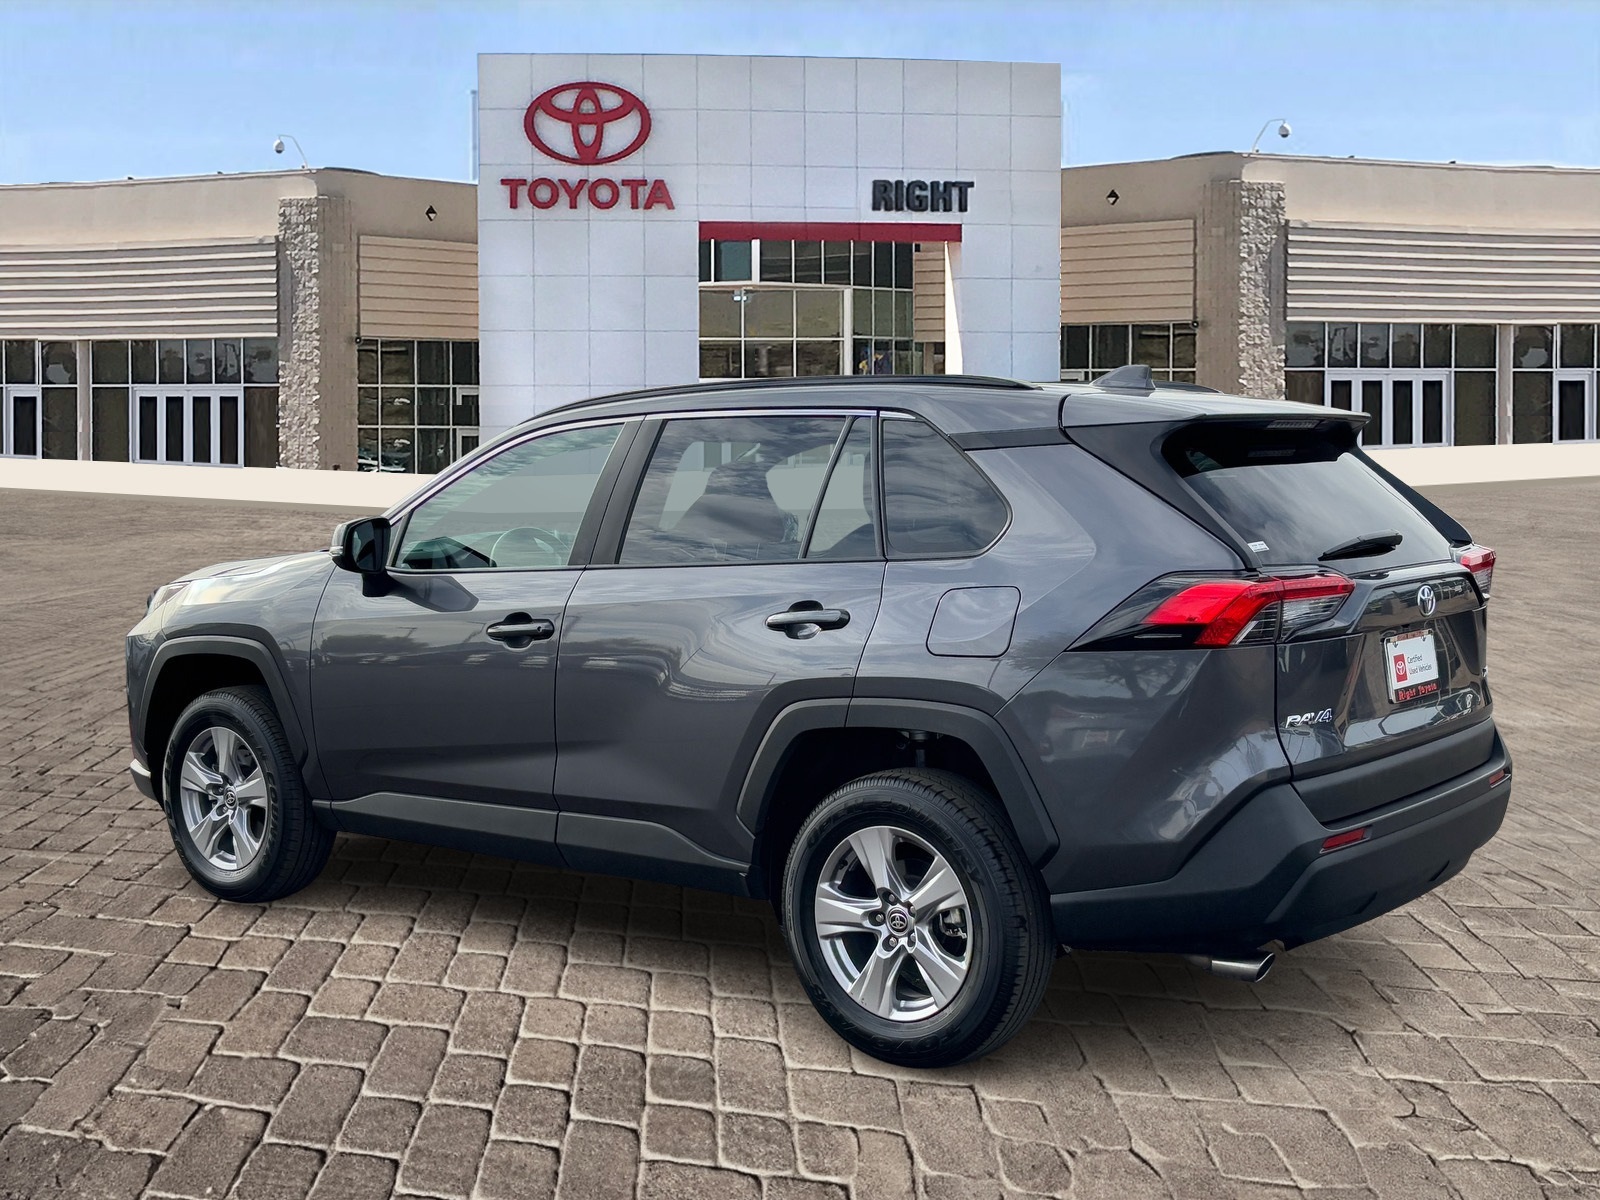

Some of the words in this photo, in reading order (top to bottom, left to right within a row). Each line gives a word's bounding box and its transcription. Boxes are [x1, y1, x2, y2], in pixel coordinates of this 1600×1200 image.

[500, 178, 675, 210] TOYOTA
[872, 180, 974, 212] RIGHT
[1407, 654, 1423, 664] Certified
[1398, 687, 1416, 701] Right
[1418, 683, 1437, 695] Toyota
[1285, 708, 1333, 729] RAV4
